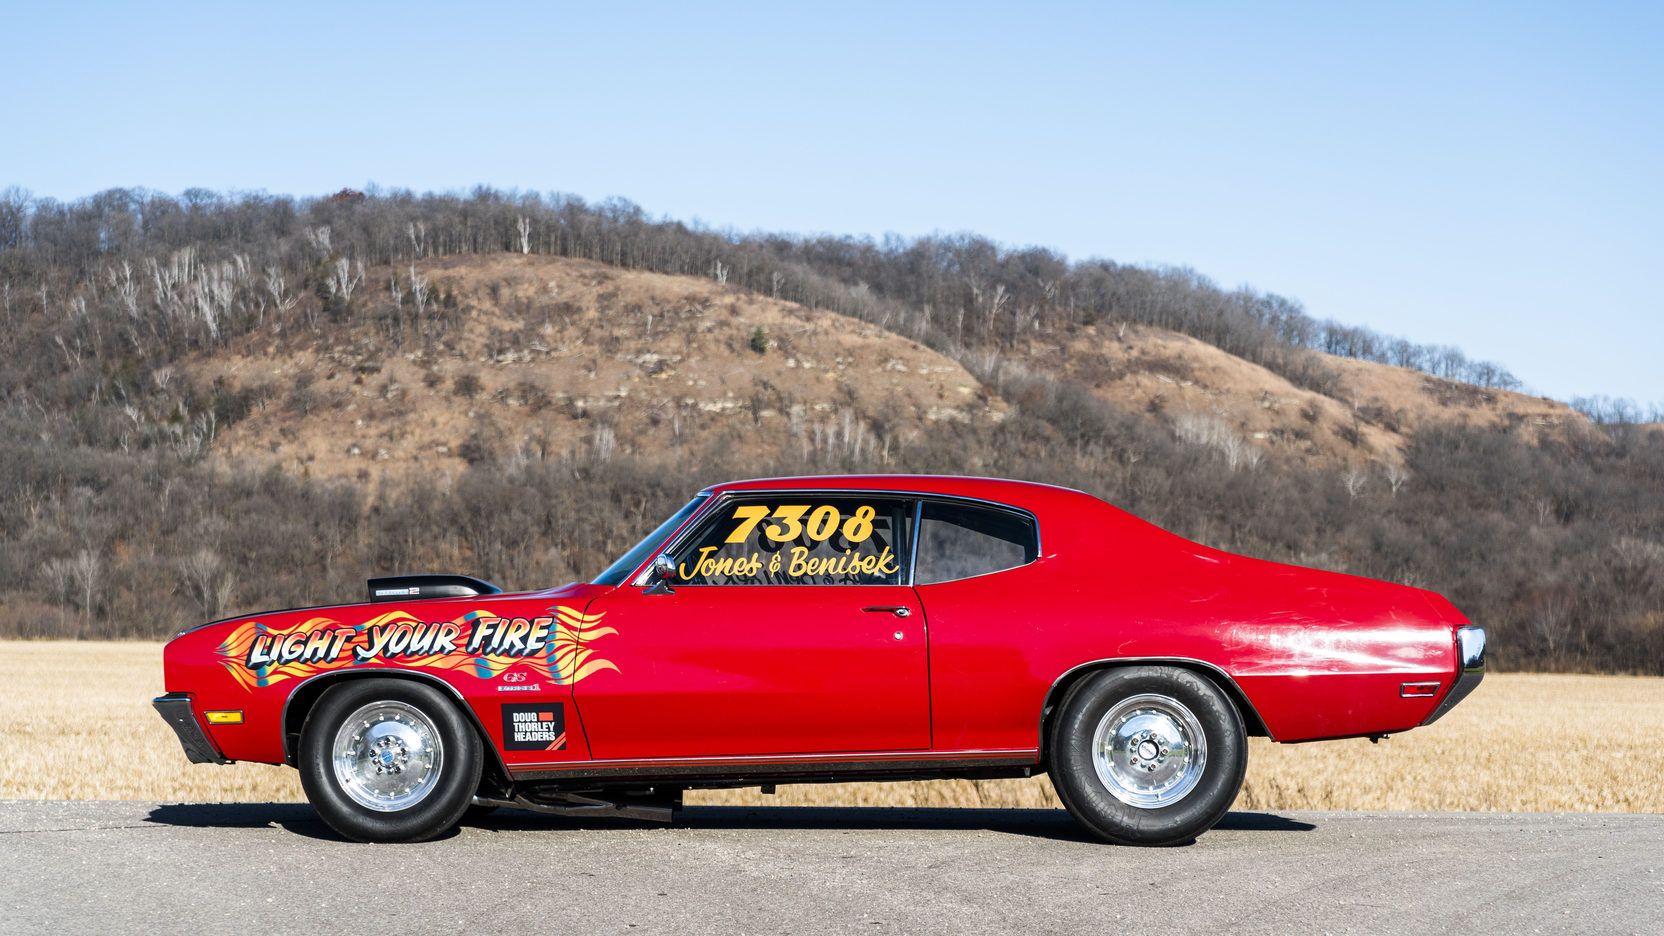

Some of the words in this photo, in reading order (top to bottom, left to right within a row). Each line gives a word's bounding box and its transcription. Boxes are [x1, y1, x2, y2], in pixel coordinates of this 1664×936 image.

[724, 505, 876, 543] 7308
[680, 546, 762, 580] Jones
[769, 551, 781, 577] &
[790, 546, 899, 576] Benisek
[246, 628, 356, 669] LIGHT
[353, 622, 461, 661] YOUR
[465, 617, 554, 657] FIRE
[512, 712, 537, 722] DOUG
[513, 722, 555, 732] THORLEY
[514, 732, 555, 741] HEADERS
